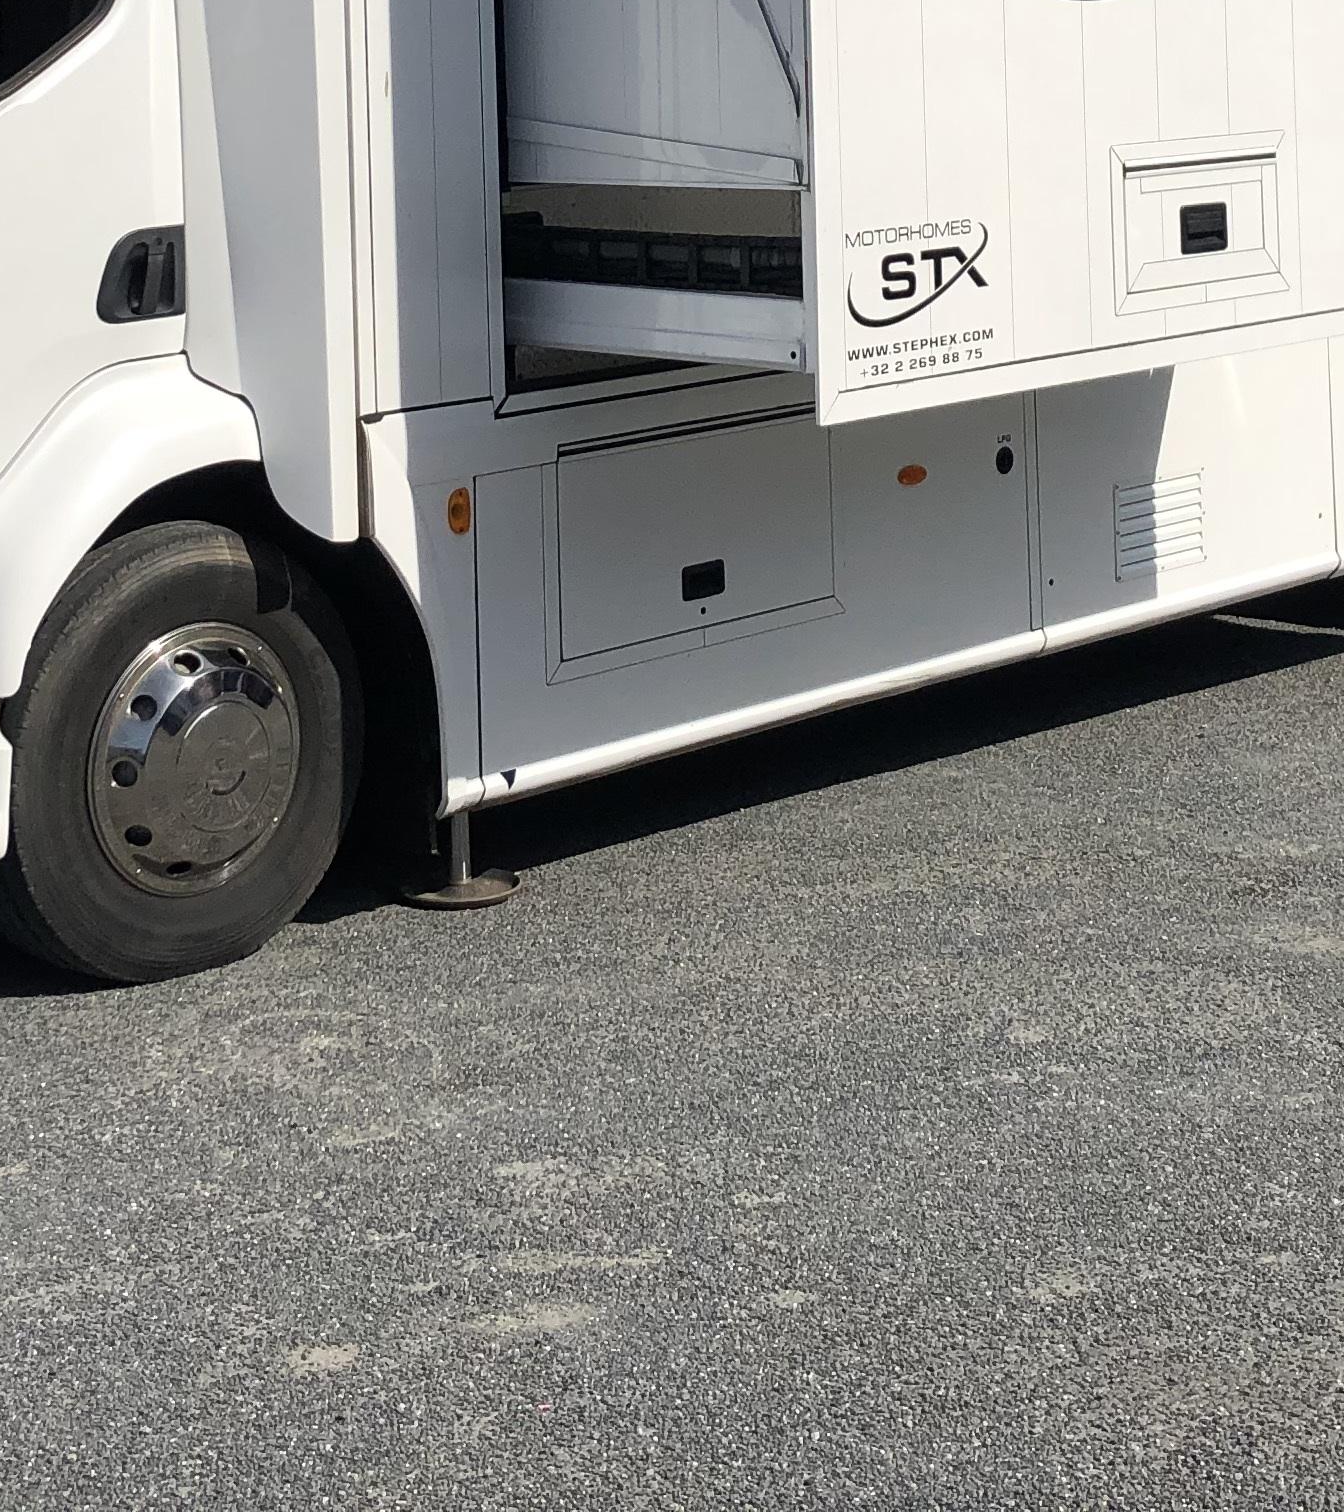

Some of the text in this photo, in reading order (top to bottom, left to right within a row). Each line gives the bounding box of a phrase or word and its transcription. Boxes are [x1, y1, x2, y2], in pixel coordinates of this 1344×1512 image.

[845, 218, 972, 249] MOTORHOMES
[881, 245, 990, 301] STX
[847, 327, 995, 362] WWW.STEPHEX.COM
[860, 347, 984, 379] +32 2 269 88 75
